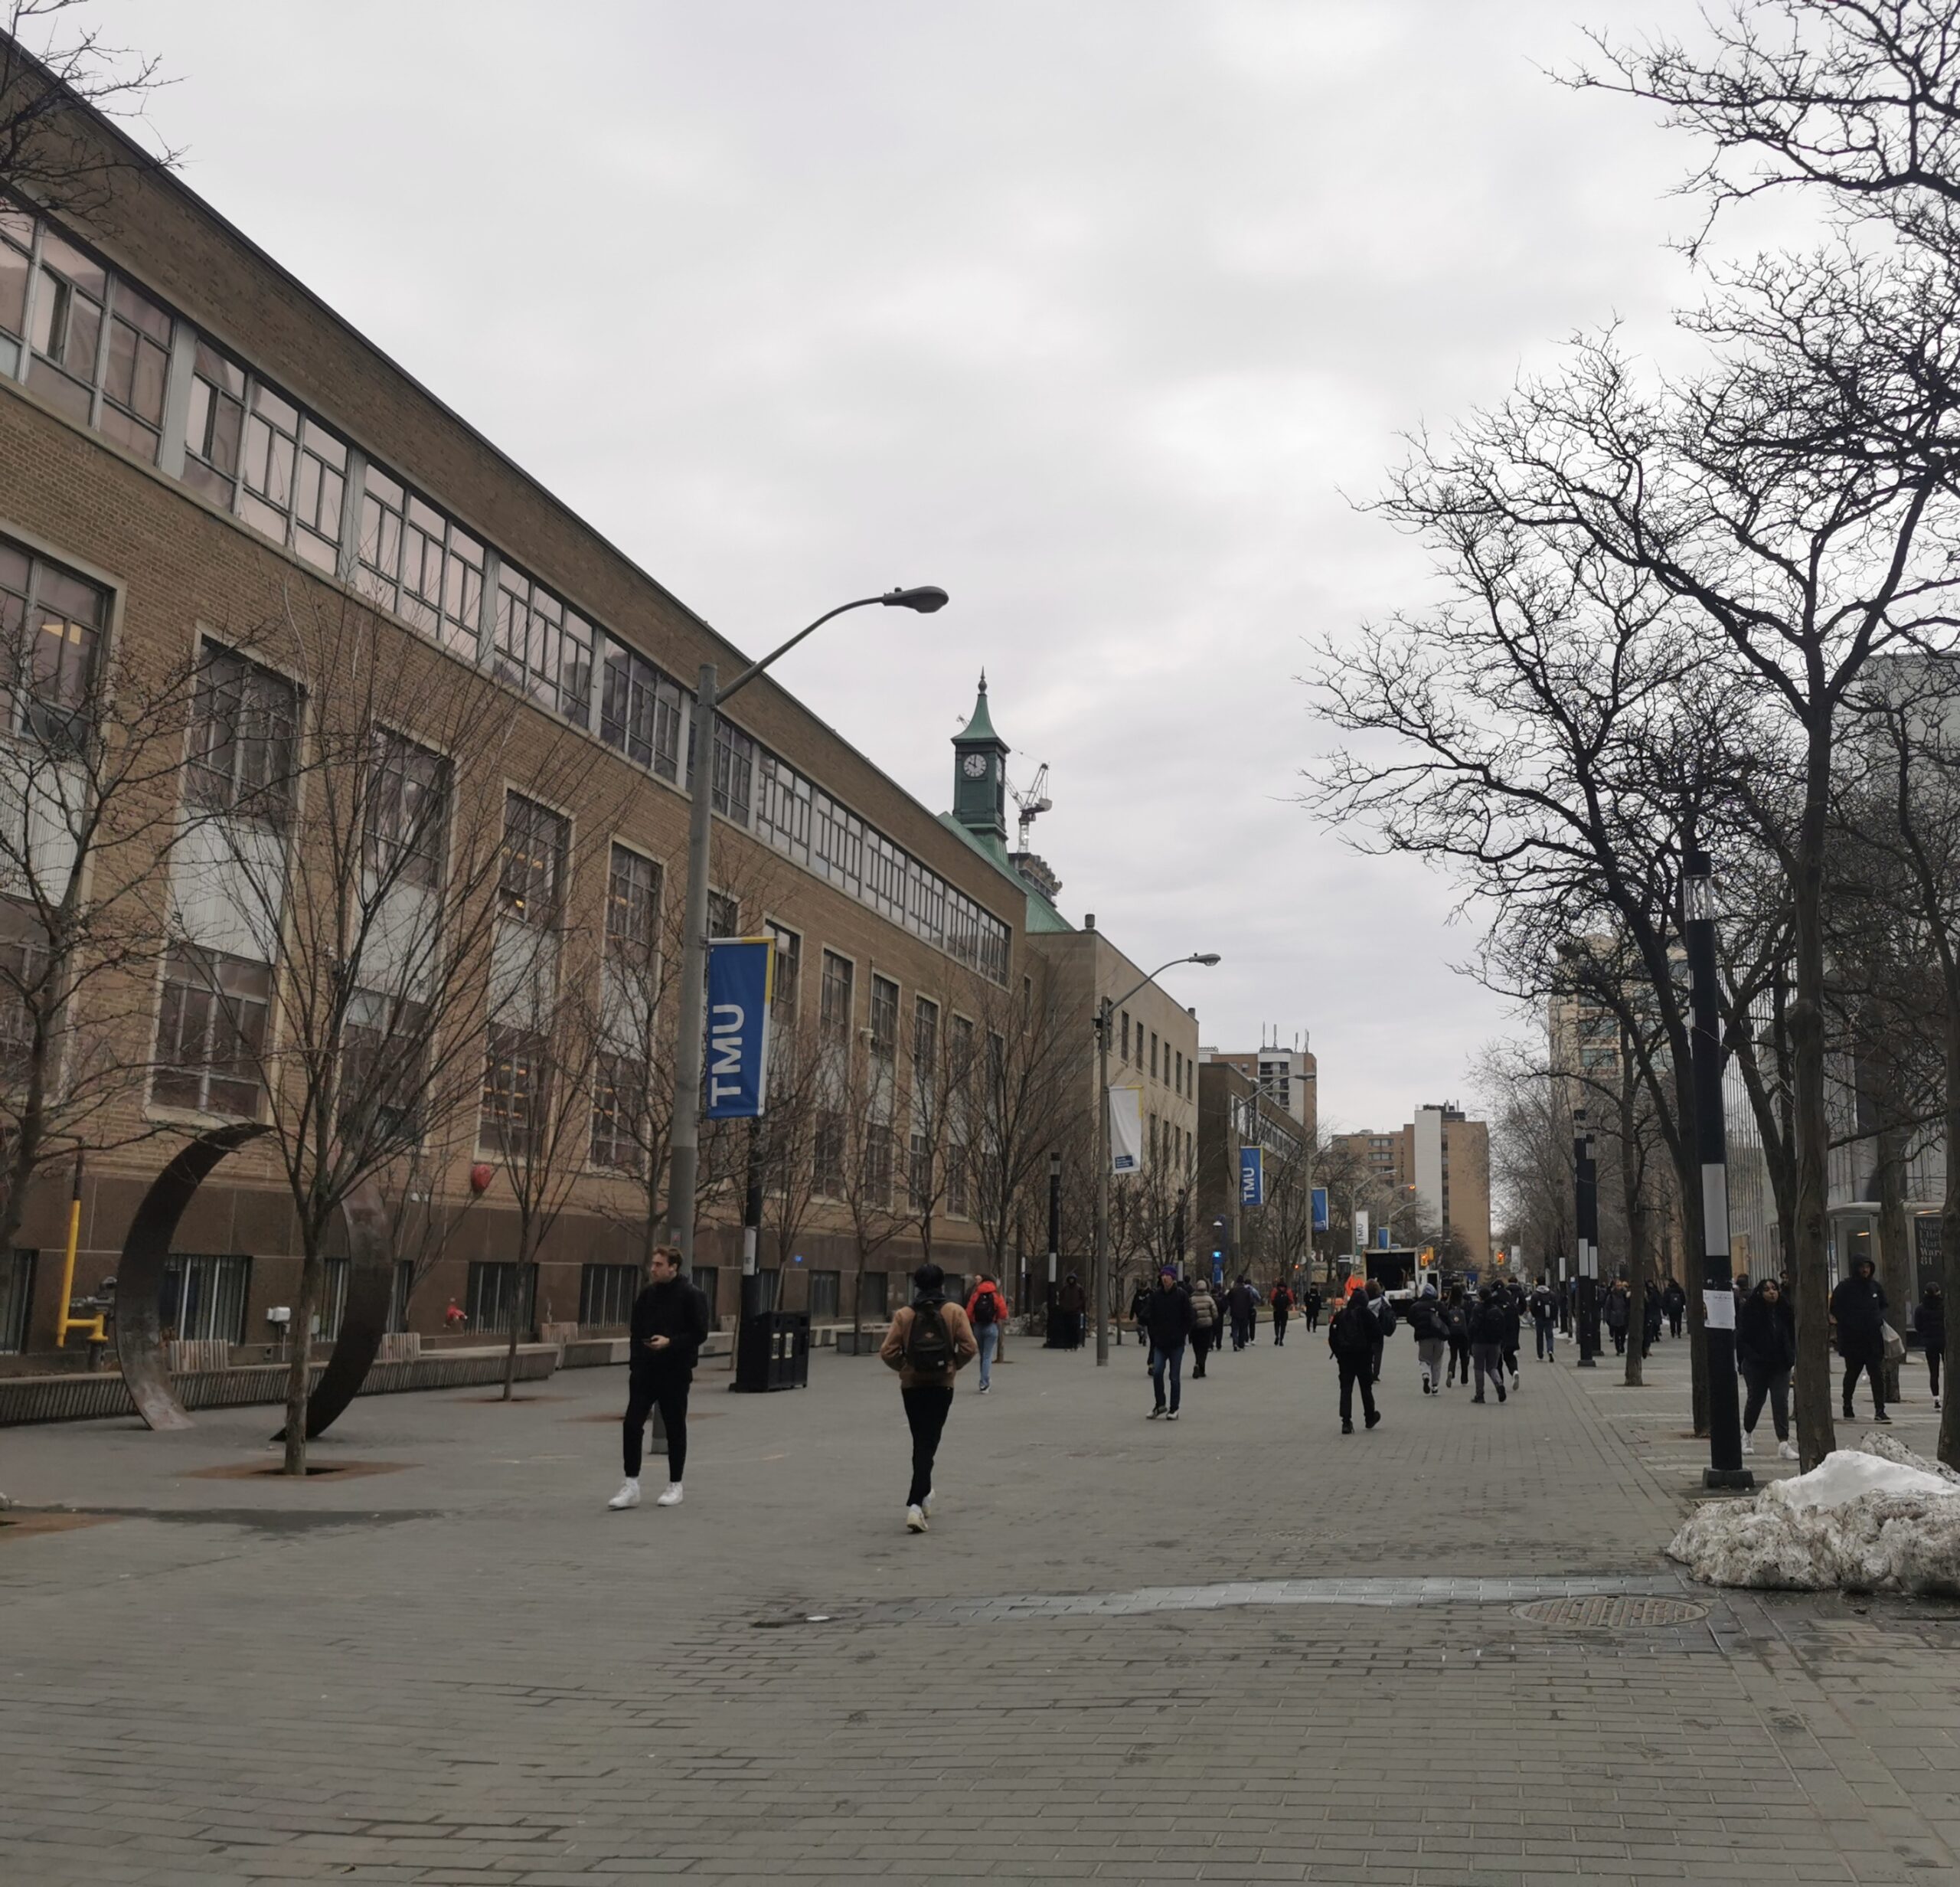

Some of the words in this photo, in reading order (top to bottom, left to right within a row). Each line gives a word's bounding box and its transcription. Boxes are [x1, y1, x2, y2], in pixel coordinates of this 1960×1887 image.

[711, 1004, 744, 1107] TMU
[1243, 1167, 1255, 1202] TMU
[1919, 1238, 1942, 1248] Mar
